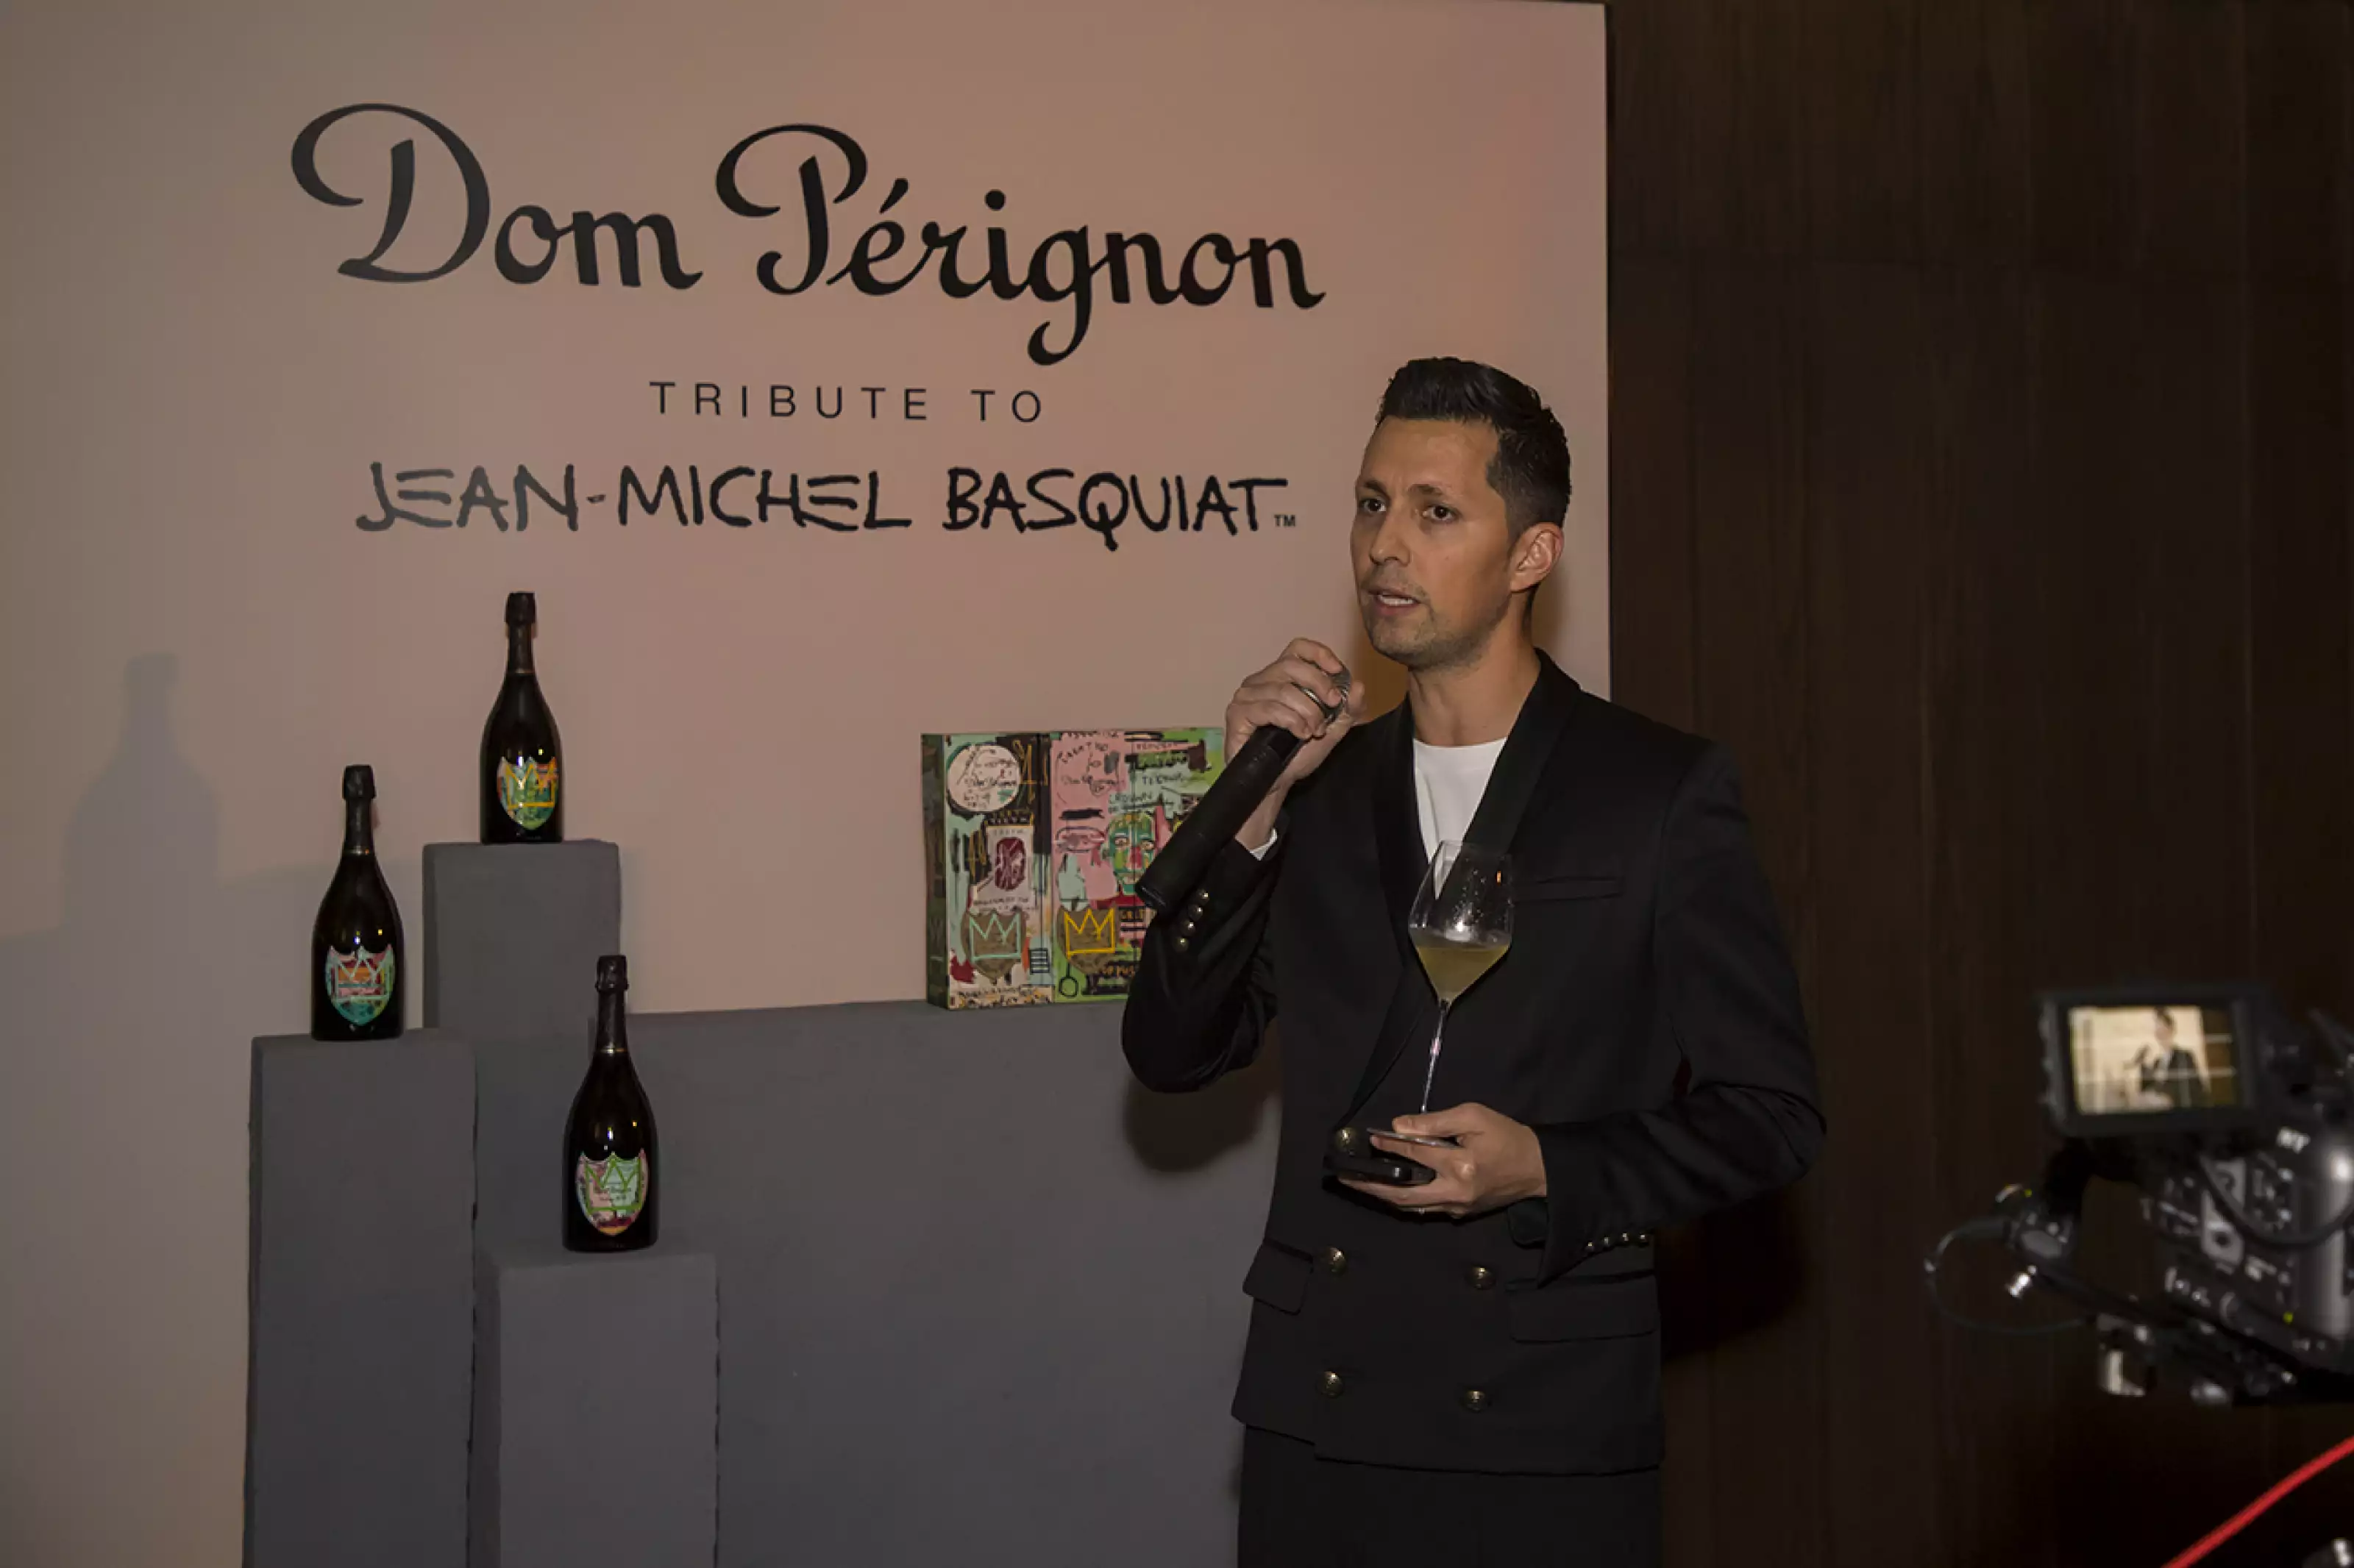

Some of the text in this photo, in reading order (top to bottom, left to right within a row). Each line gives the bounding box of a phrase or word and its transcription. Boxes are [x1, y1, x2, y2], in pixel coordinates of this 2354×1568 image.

[291, 103, 1327, 366] Dom Pérignon
[649, 381, 1041, 423] TRIBUTE TO
[356, 462, 912, 532] JEAN-MICHEL
[942, 466, 1289, 552] BASQUIAT
